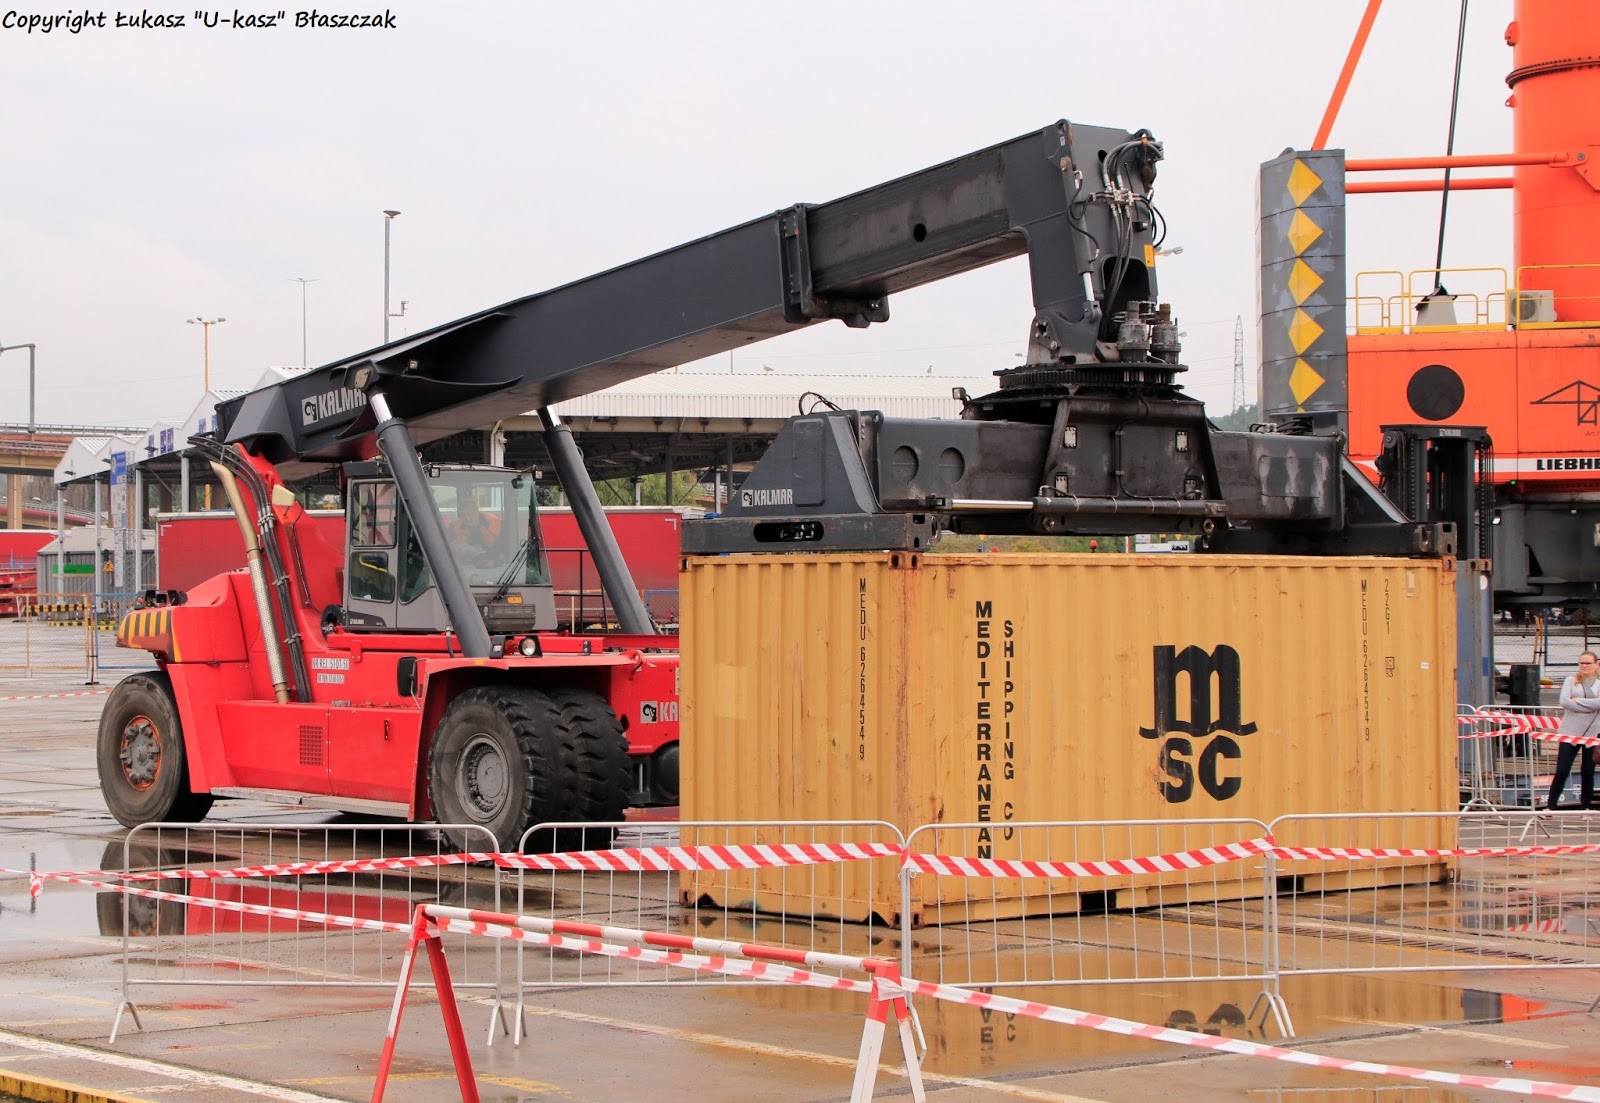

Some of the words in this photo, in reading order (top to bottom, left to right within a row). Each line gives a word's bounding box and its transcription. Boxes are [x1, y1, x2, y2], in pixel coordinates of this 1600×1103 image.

[754, 489, 793, 505] KALMAR
[1536, 458, 1600, 470] LIEBHE
[975, 600, 992, 859] MEDITERRANEAN
[1003, 619, 1014, 780] SHIPPING
